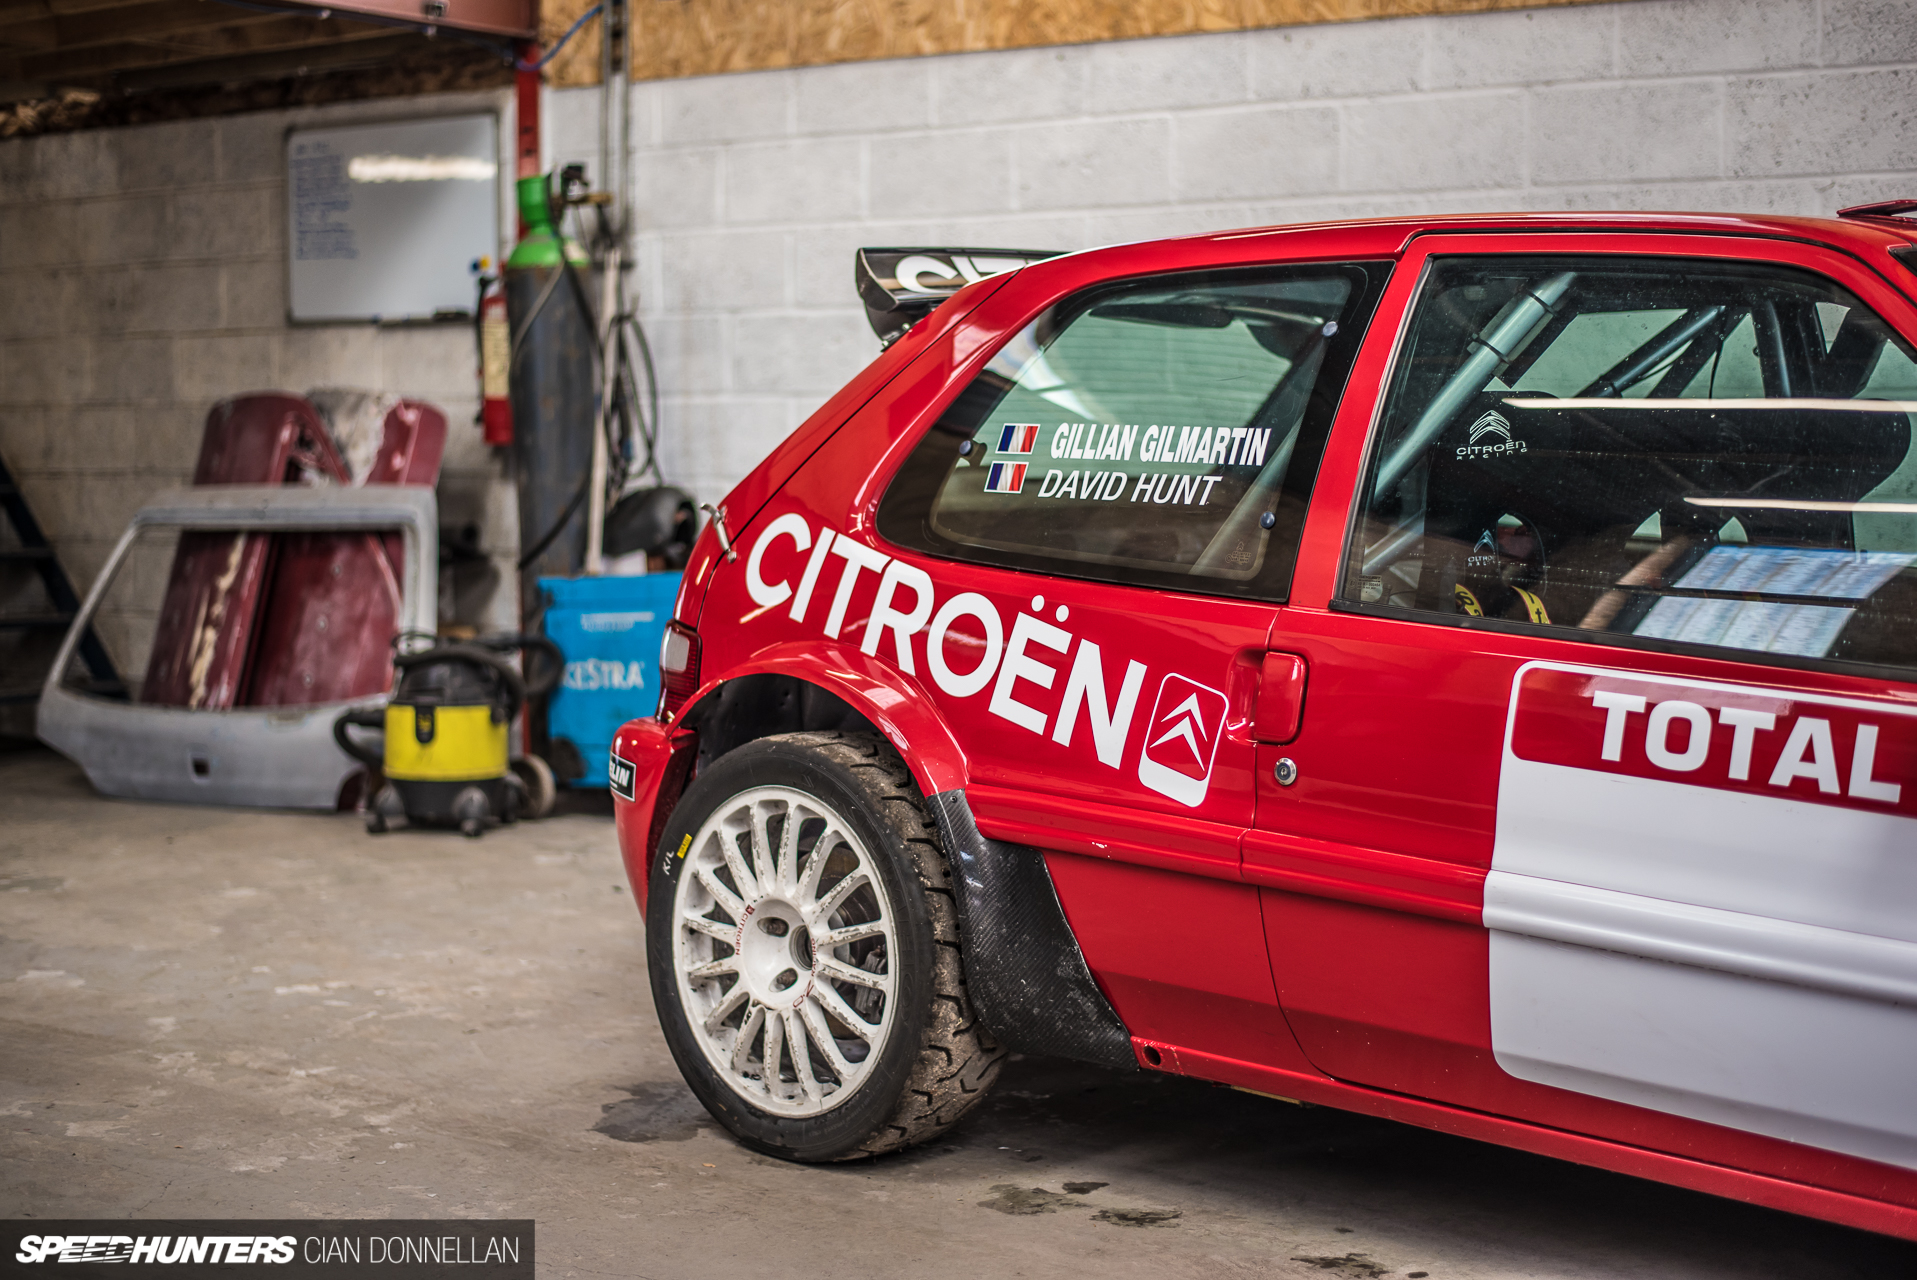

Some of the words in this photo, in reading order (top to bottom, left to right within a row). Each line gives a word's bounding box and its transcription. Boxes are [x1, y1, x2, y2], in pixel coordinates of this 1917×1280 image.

[1050, 422, 1139, 461] GILLIAN
[1139, 424, 1271, 466] GILMARTIN
[1037, 469, 1128, 501] DAVID
[1130, 473, 1223, 506] HUNT
[745, 513, 1148, 770] CITROËN
[1592, 690, 1901, 804] TOTAL
